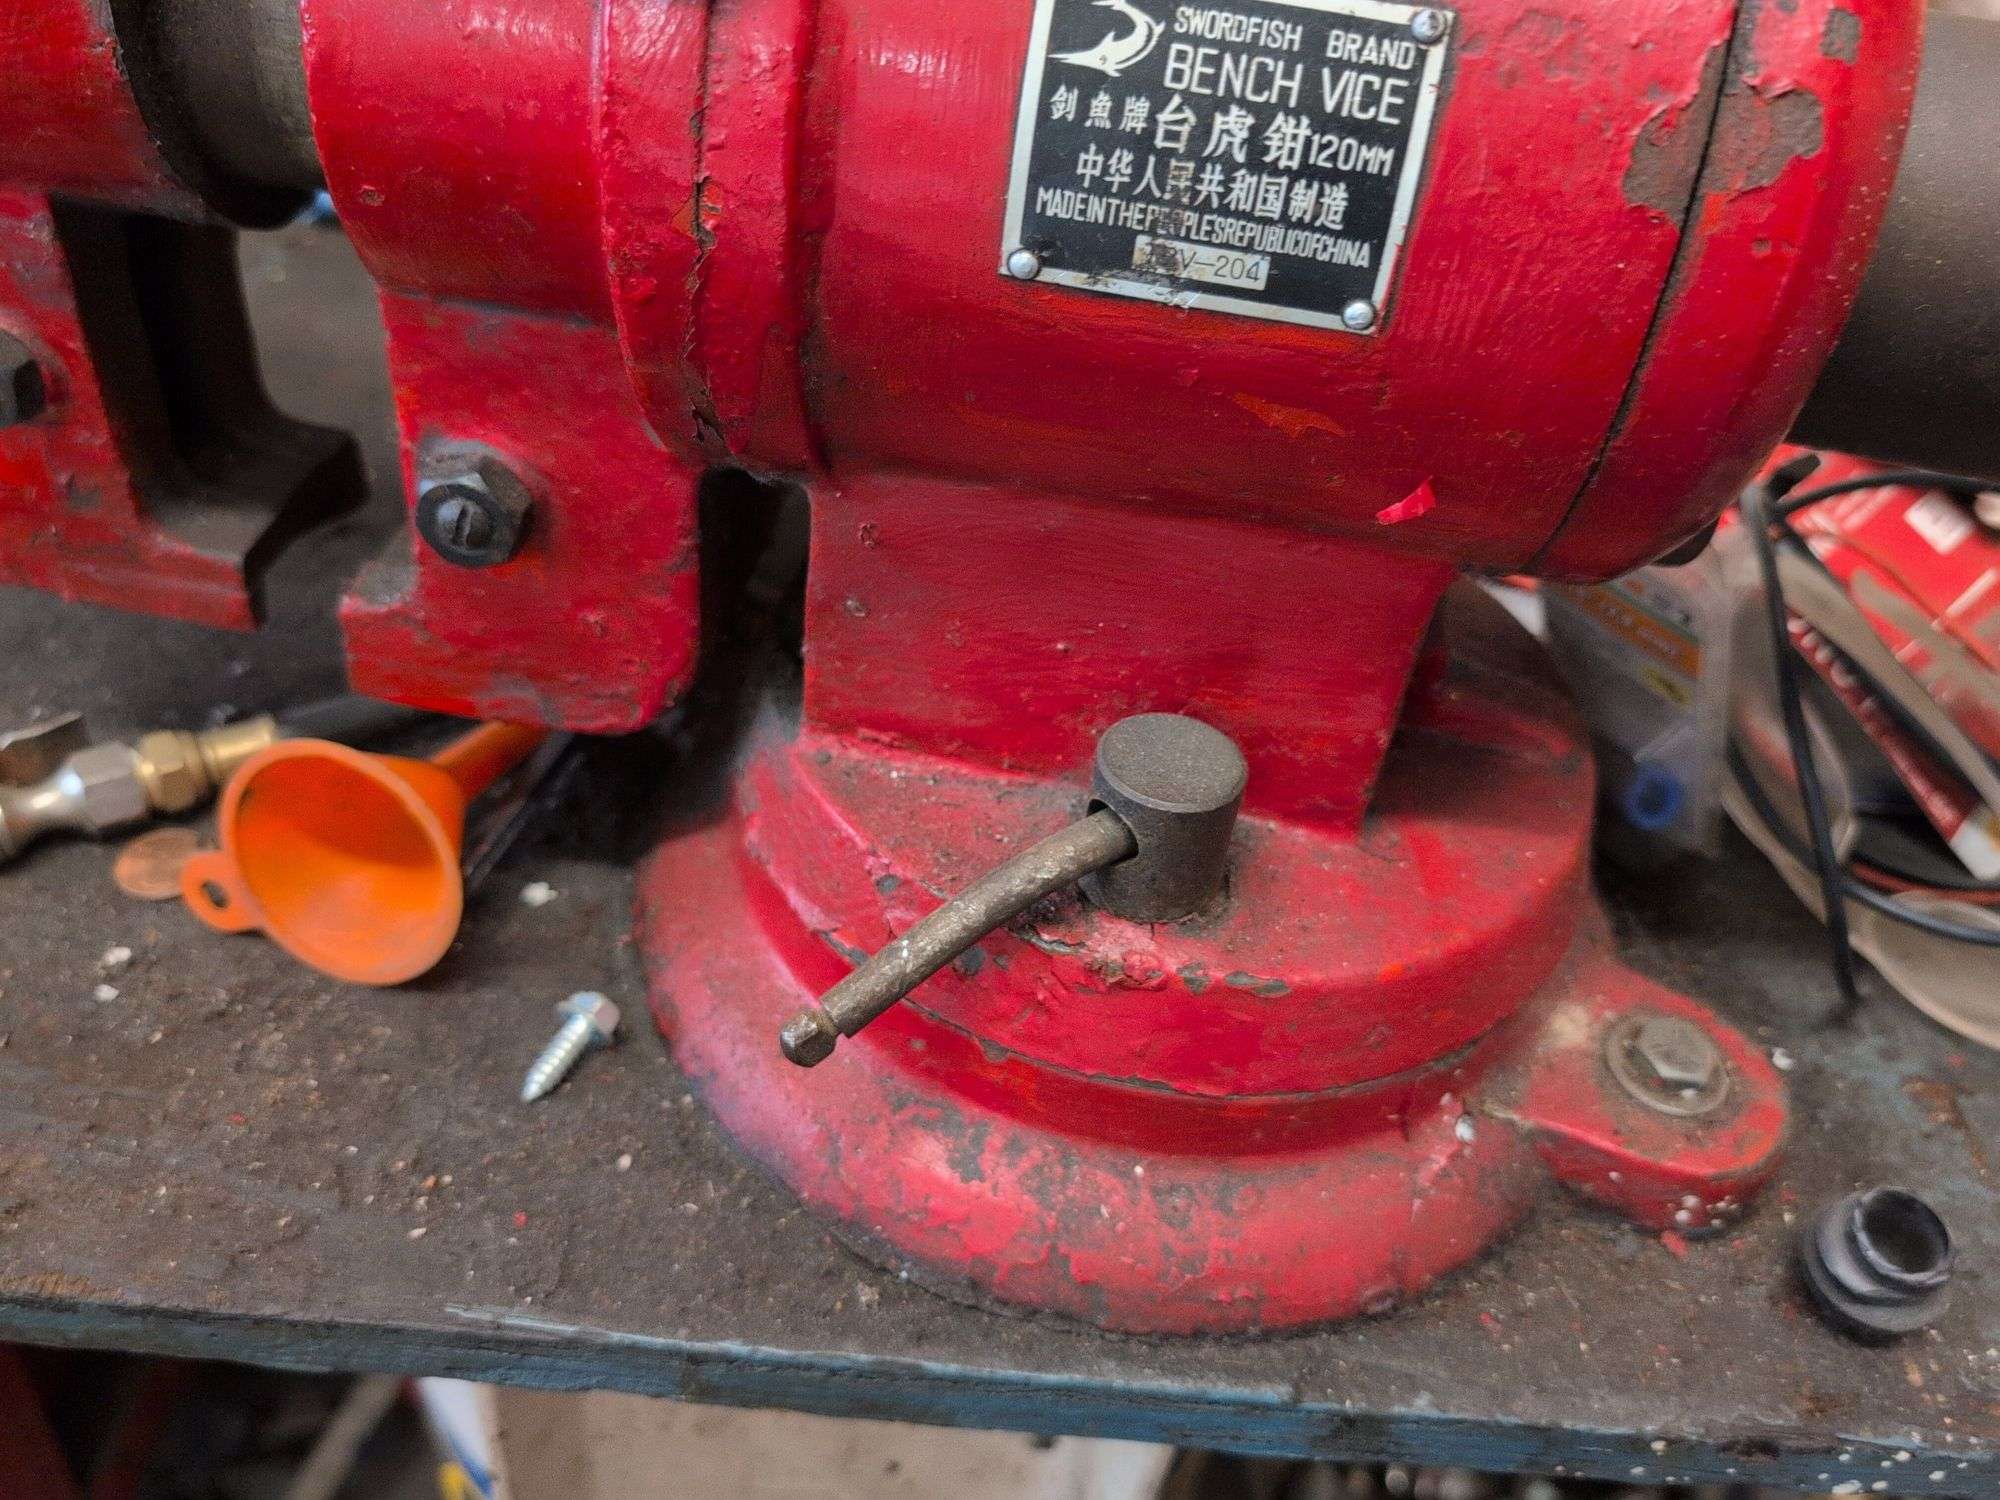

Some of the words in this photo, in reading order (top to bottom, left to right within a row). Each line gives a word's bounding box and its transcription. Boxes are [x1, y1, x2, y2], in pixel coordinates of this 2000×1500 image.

[1174, 6, 1303, 52] SWORDFISH
[1326, 29, 1416, 70] BRAND
[1163, 43, 1303, 108] BENCH
[1321, 66, 1410, 125] VICE
[1076, 142, 1349, 231] 中华人民共和国制造
[1308, 133, 1395, 176] 120MM
